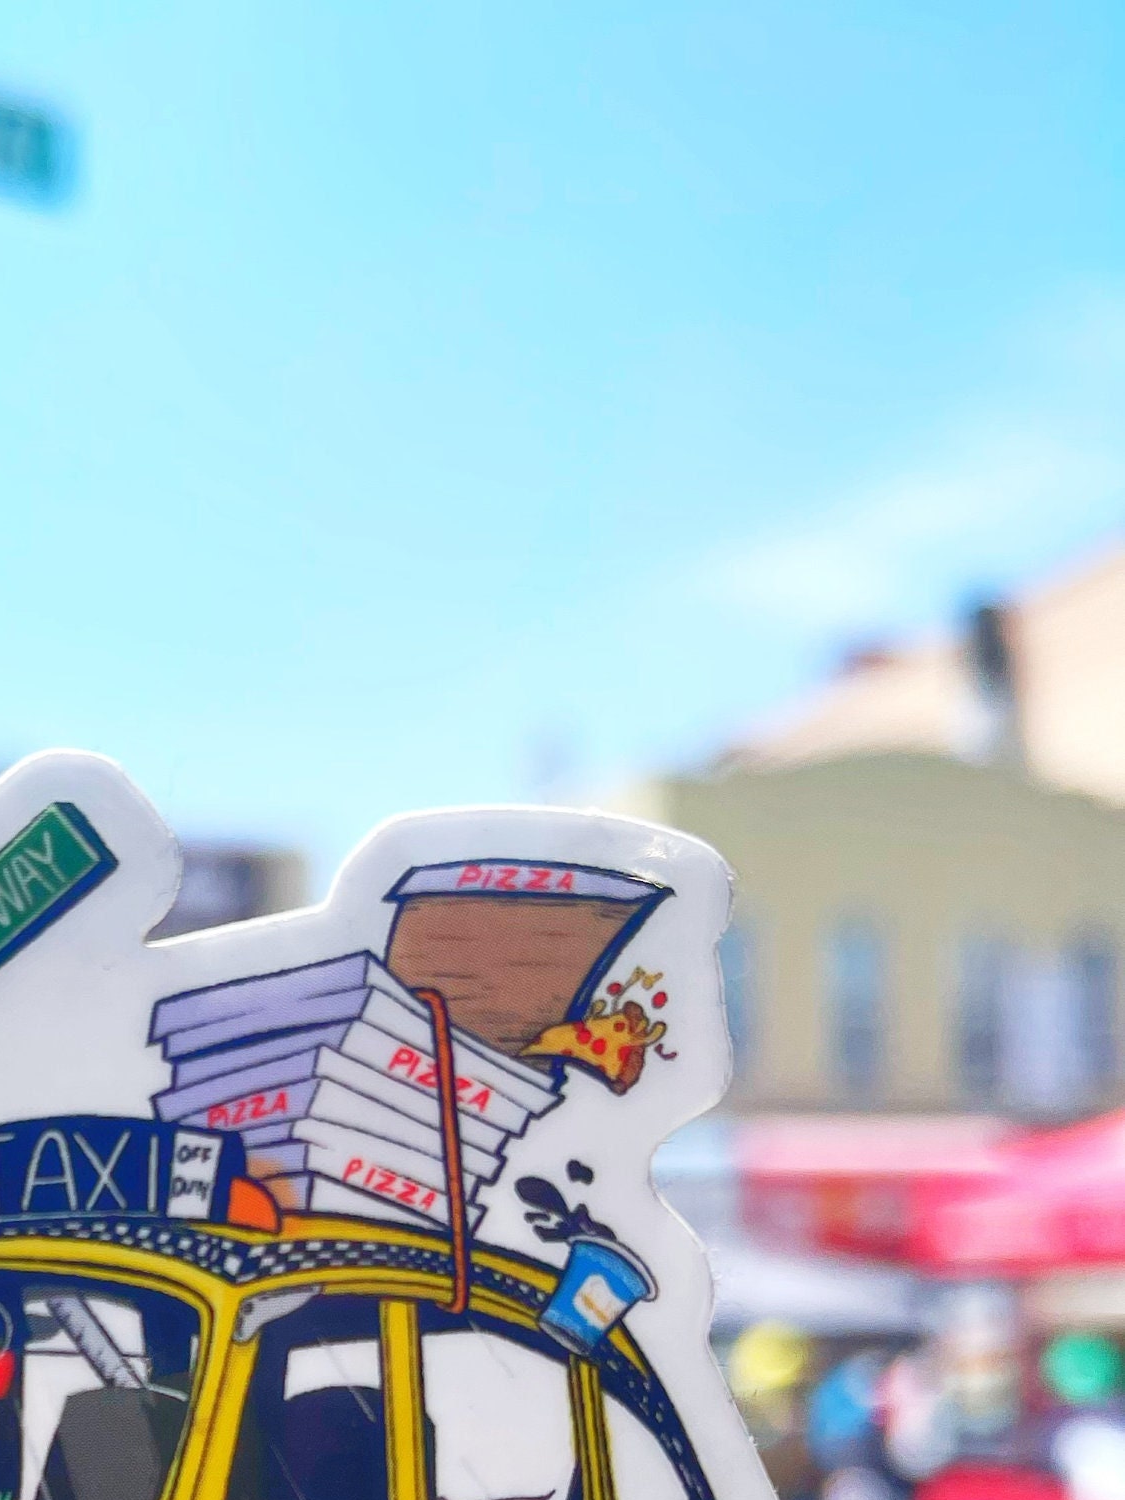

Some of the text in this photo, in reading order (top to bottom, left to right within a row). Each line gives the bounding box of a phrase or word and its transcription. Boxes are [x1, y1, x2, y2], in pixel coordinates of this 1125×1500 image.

[456, 864, 574, 891] PIZZA
[207, 1091, 288, 1129] PIZZA
[342, 1157, 437, 1210] PIZZA
